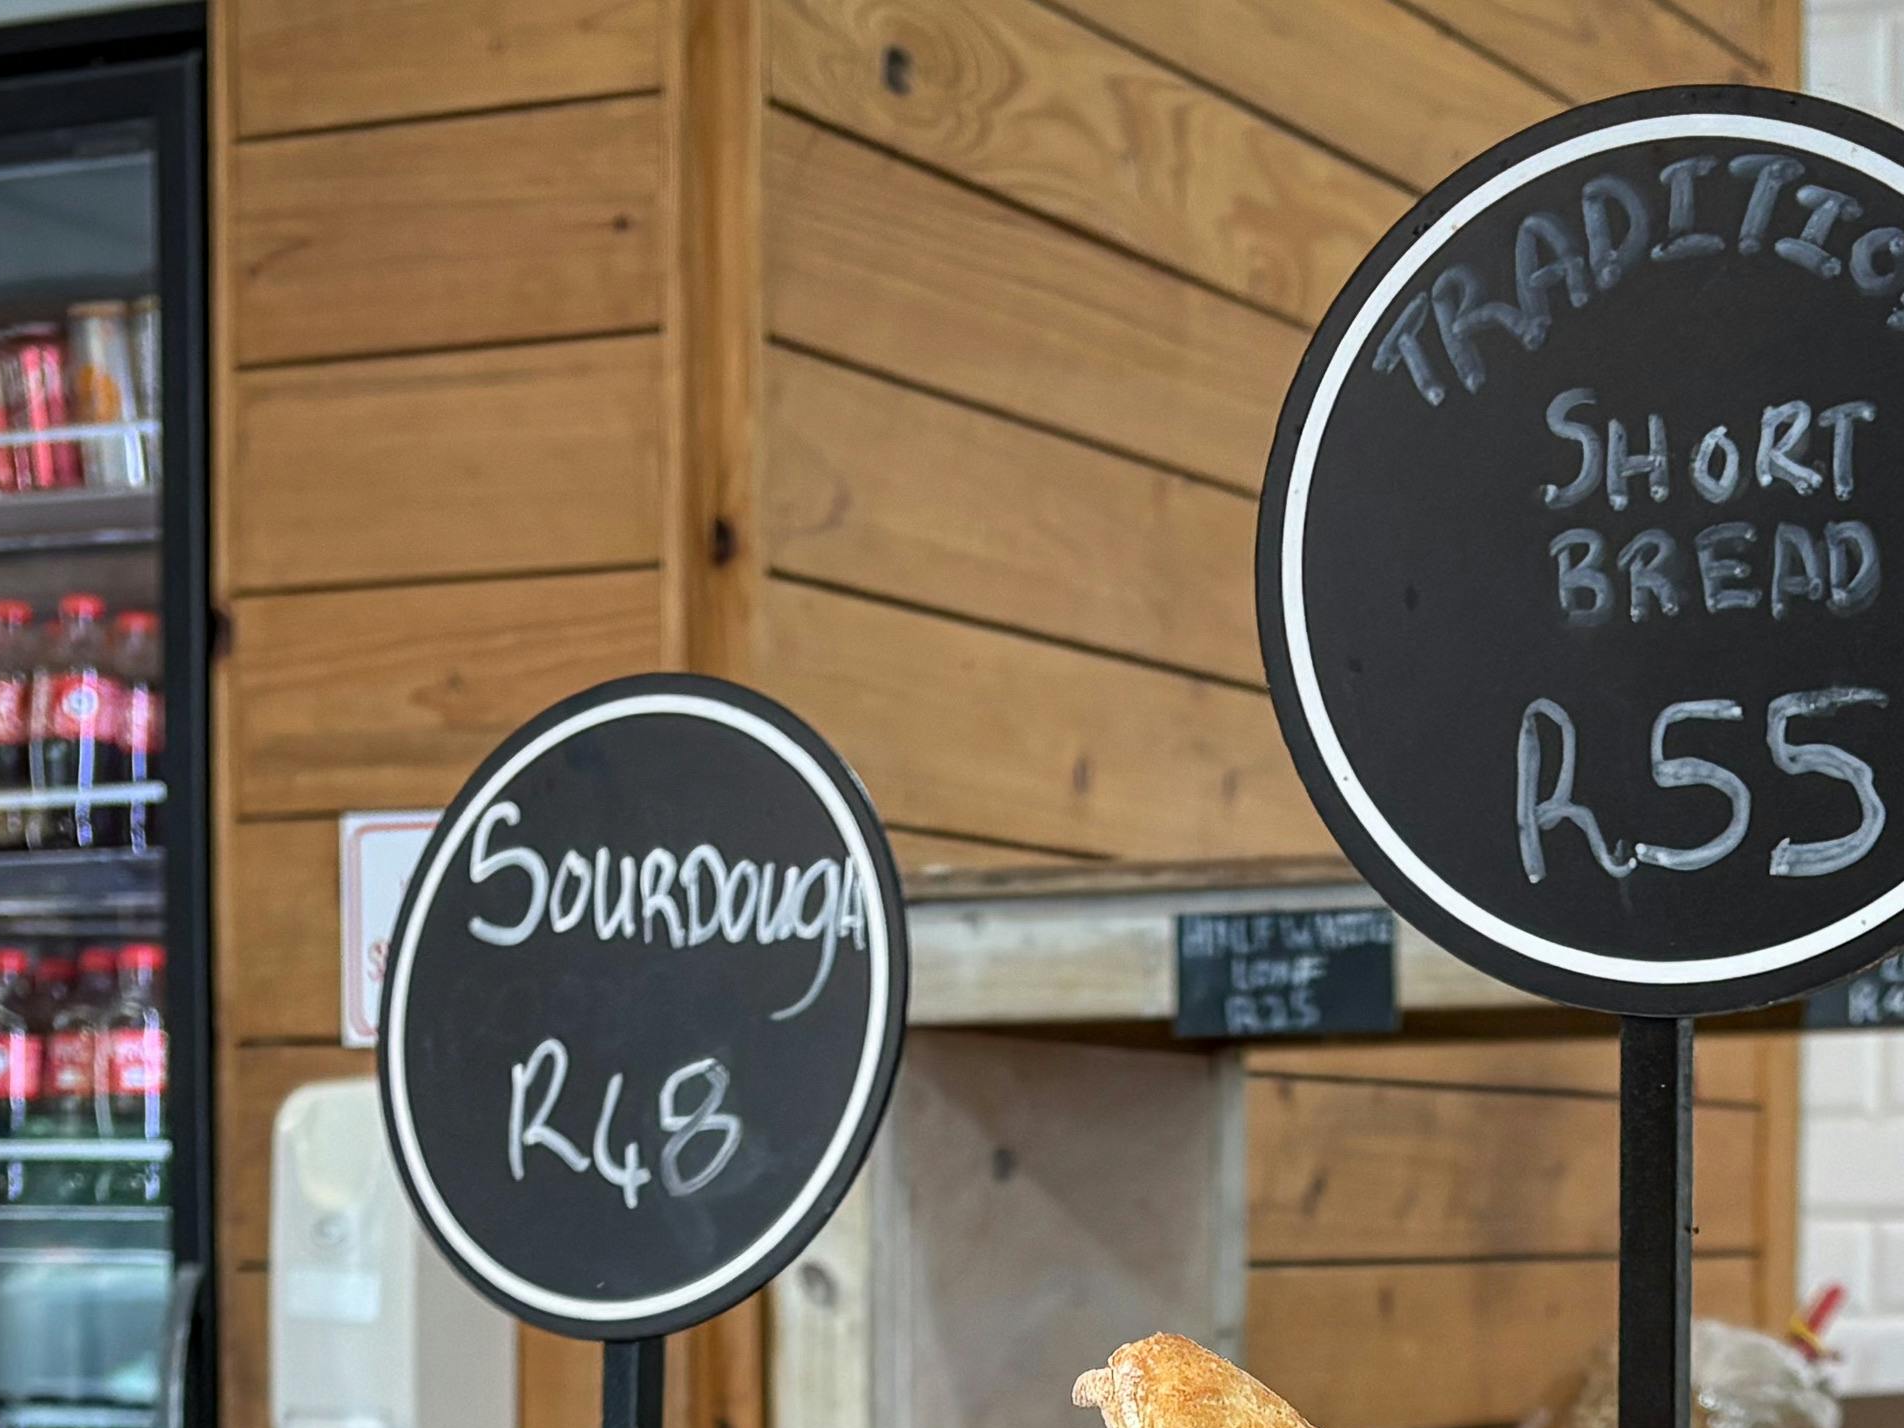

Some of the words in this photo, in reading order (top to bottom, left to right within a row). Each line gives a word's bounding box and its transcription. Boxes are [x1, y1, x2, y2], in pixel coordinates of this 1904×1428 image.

[1540, 388, 1877, 510] SHORT
[1550, 519, 1882, 624] BREAD
[1516, 686, 1889, 884] R55
[508, 1039, 741, 1208] R48
